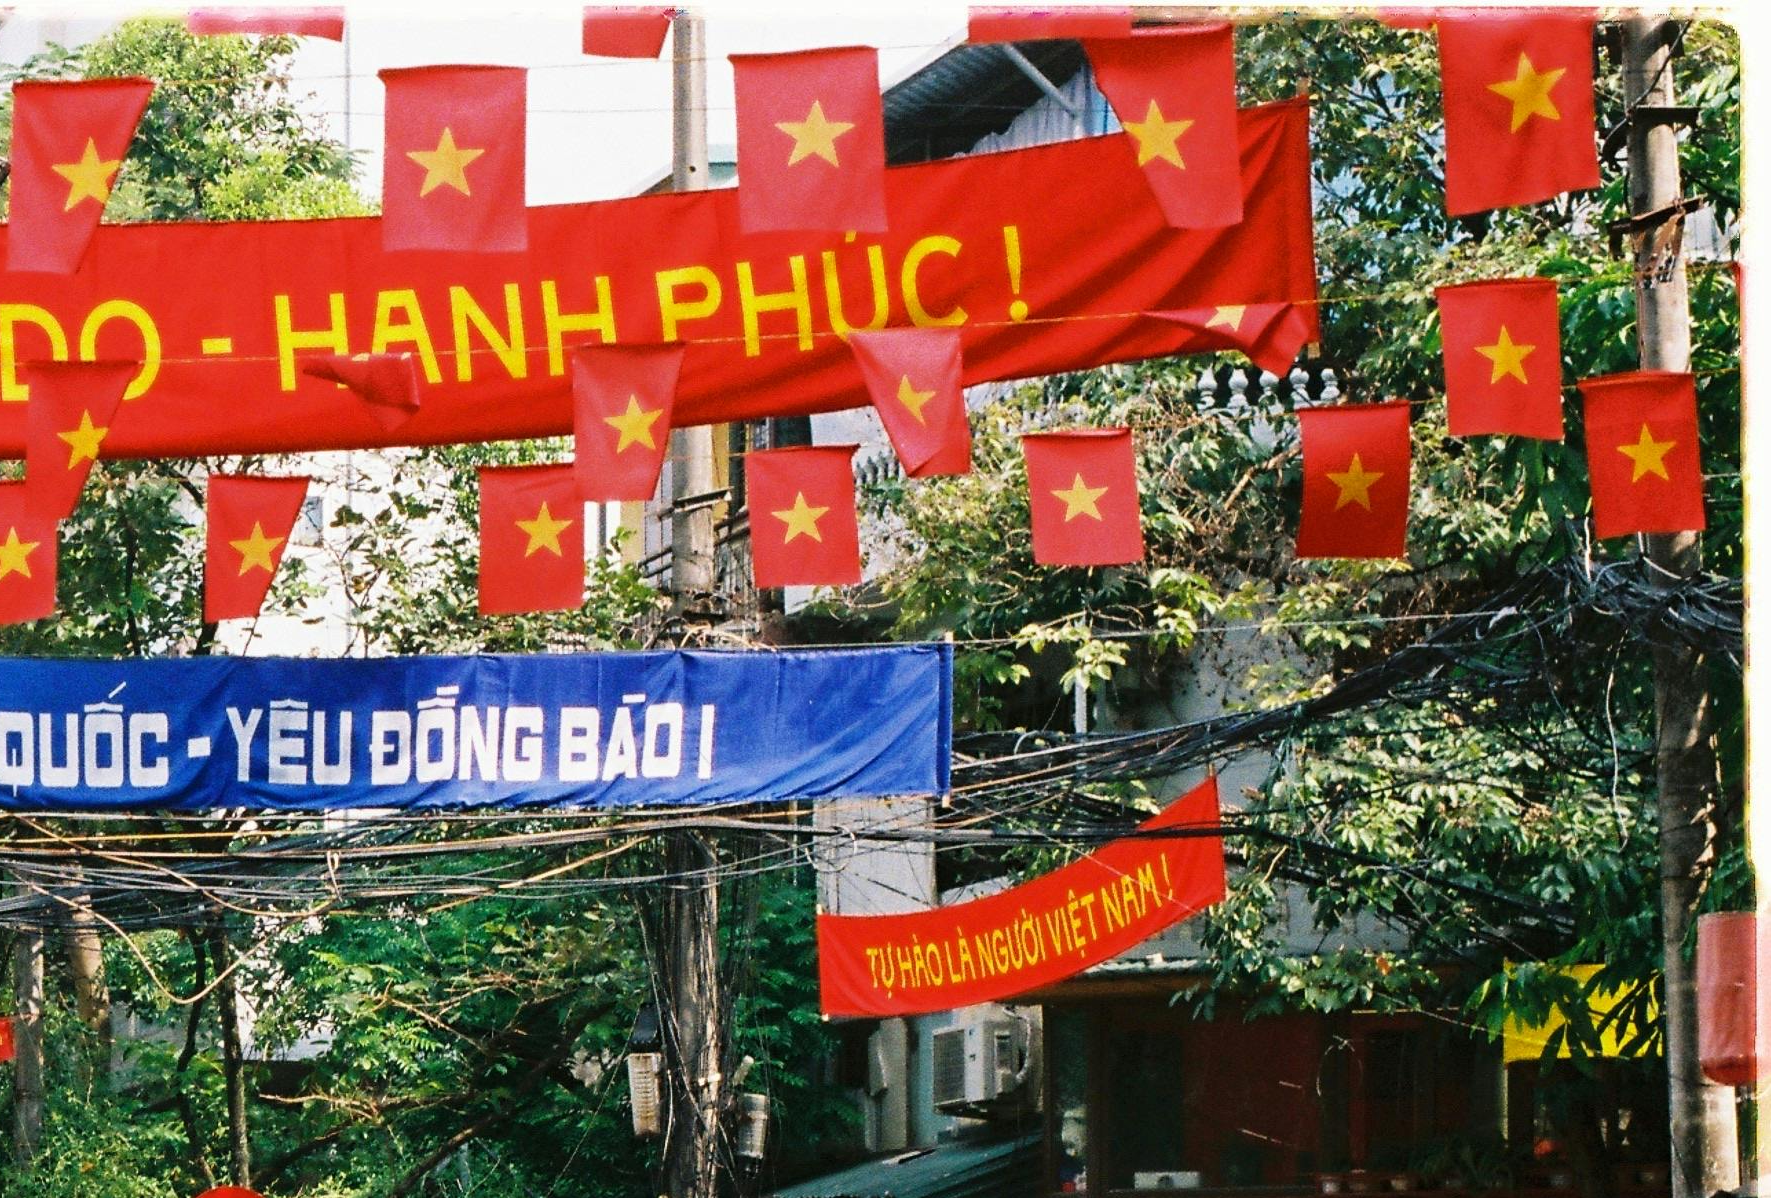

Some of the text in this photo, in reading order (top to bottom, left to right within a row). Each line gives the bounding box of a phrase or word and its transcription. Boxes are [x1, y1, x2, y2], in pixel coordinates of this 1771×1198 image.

[201, 338, 232, 355] -
[655, 231, 969, 358] PHÚC
[1003, 225, 1029, 324] !
[187, 736, 212, 758] -
[226, 699, 352, 786] YÊU
[865, 852, 1174, 999] TỰ HÀO LÀ NGƯỜI VIỆT NAM !
